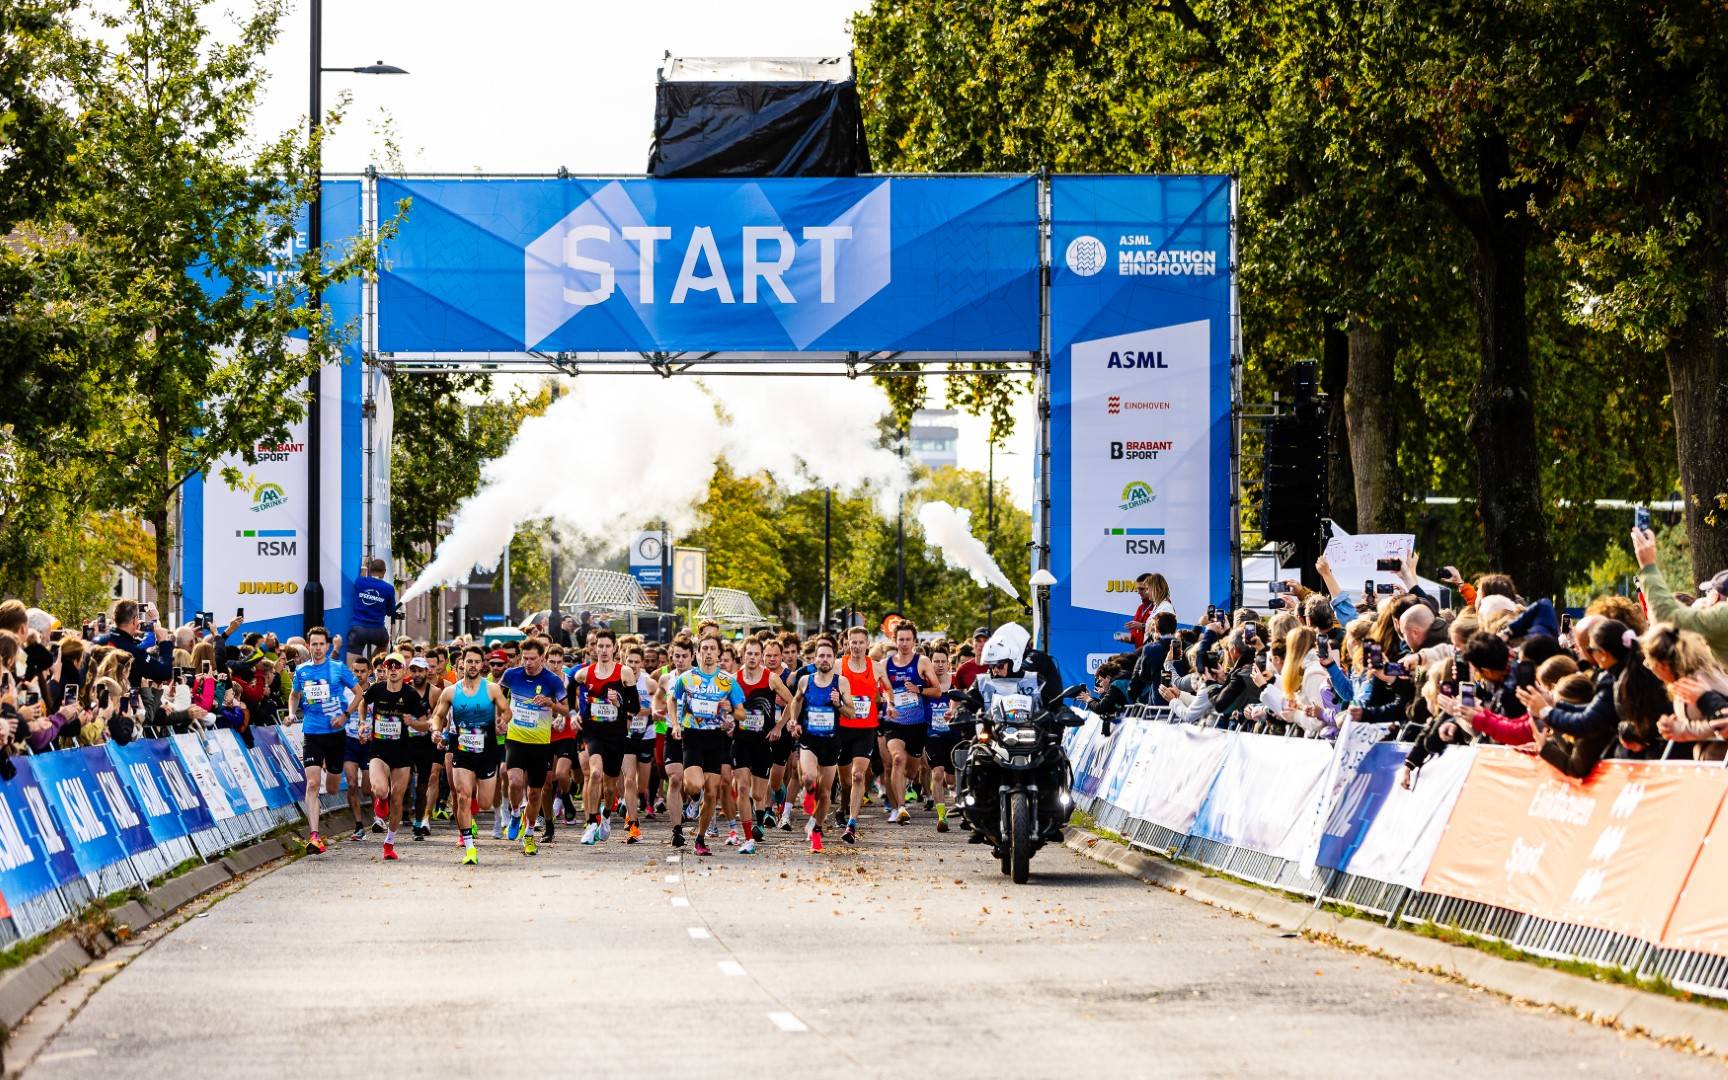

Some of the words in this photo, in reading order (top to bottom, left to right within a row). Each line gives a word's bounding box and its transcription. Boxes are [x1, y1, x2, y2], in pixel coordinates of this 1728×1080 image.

[1119, 235, 1151, 245] ASML
[1119, 251, 1215, 262] MARATHON
[563, 225, 852, 305] START
[1119, 264, 1215, 275] EINDHOVEN
[1107, 351, 1168, 368] ASML
[1126, 442, 1172, 450] BRABANT
[258, 453, 289, 461] SPORT
[1126, 451, 1158, 459] SPORT
[263, 490, 278, 503] AA
[1131, 488, 1147, 500] AA
[259, 499, 283, 510] DRINK
[1128, 497, 1152, 509] DRINK
[257, 541, 297, 556] RSM
[1126, 540, 1165, 554] RSM
[236, 582, 298, 594] JUMBO
[1105, 580, 1138, 592] JUM
[692, 685, 720, 694] ASML
[55, 776, 107, 844] ASML
